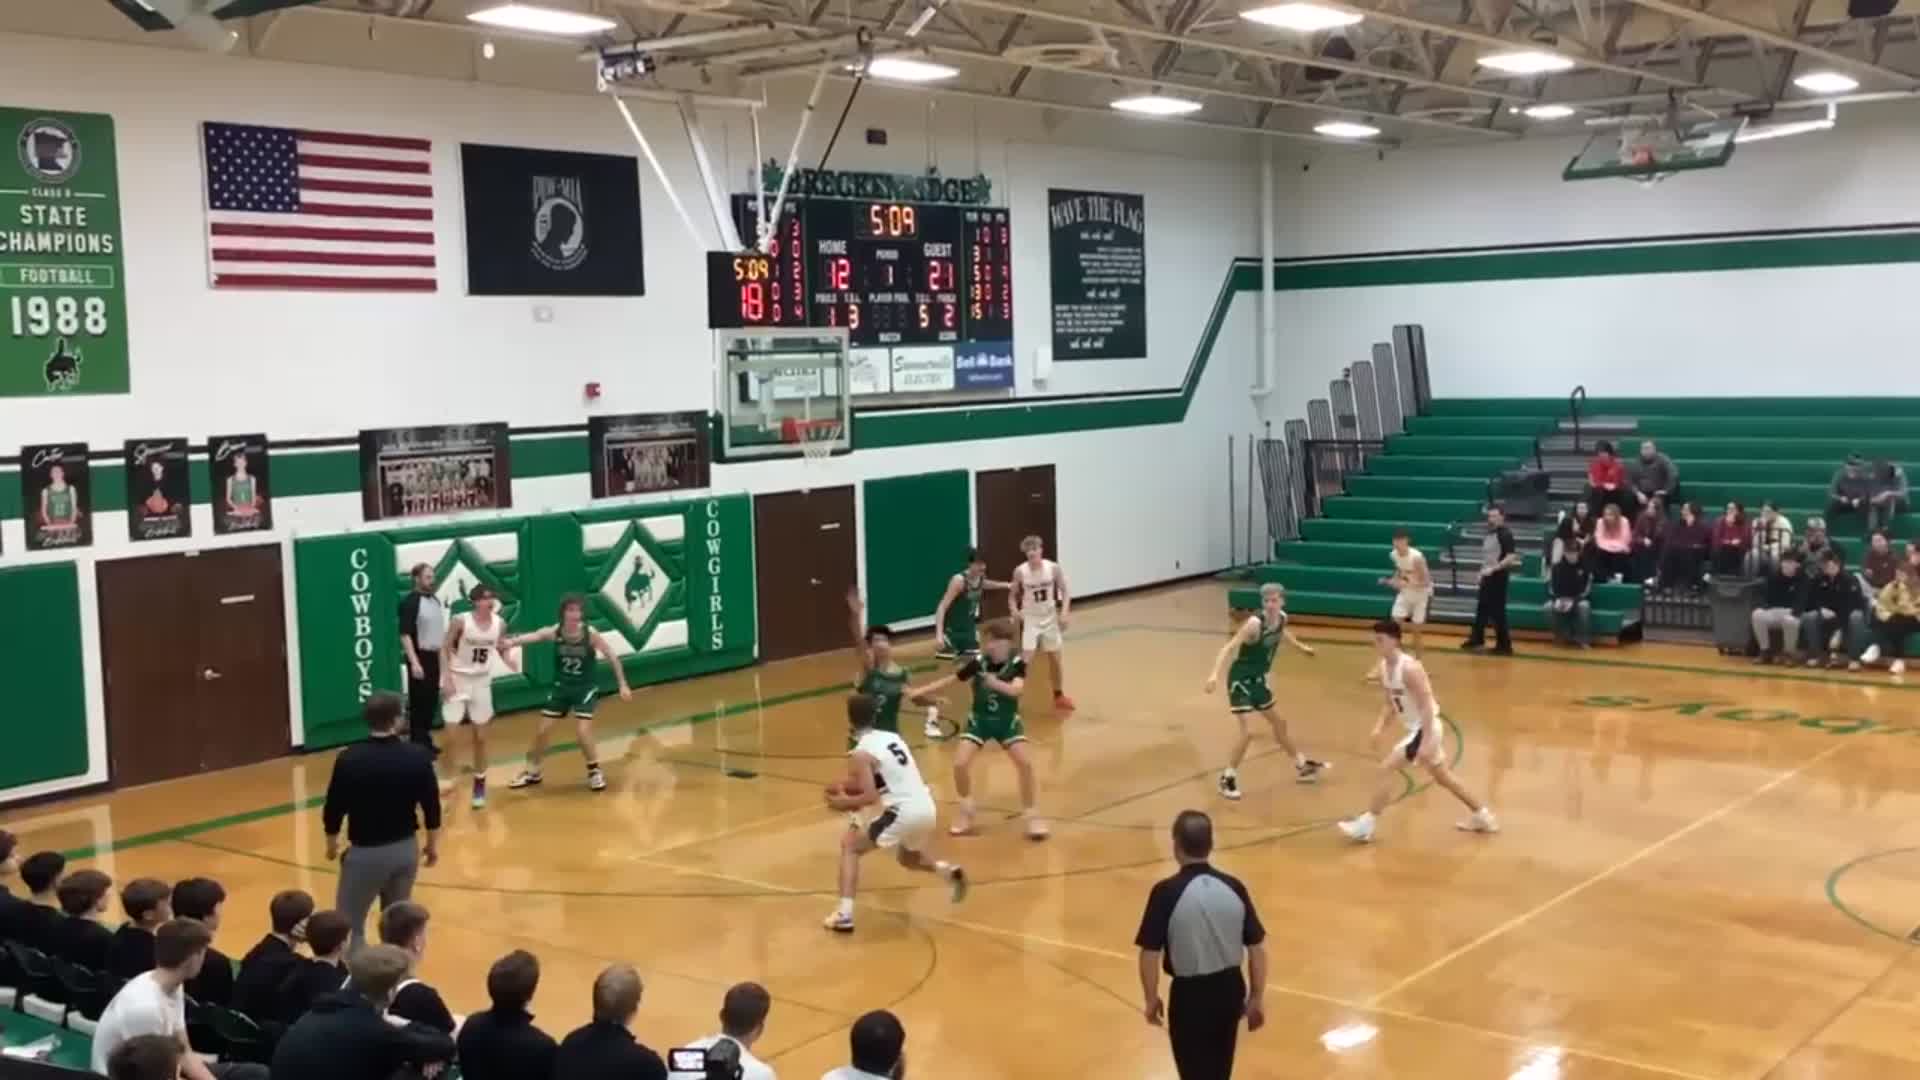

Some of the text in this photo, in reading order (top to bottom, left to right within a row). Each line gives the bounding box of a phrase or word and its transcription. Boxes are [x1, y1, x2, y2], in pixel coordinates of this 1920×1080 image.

[32, 187, 62, 198] CLASS
[20, 205, 87, 226] STATE
[871, 204, 915, 236] 5:09
[1051, 196, 1143, 234] WAVE THE FLAG
[0, 231, 113, 254] CHAMPIONS
[818, 240, 847, 254] HOME
[923, 242, 952, 257] GUEST
[20, 268, 94, 284] FOOTBALL
[733, 258, 769, 281] 5:09
[830, 258, 849, 290] 12
[887, 265, 893, 285] 1
[929, 260, 954, 290] 21
[11, 296, 108, 336] 1988
[829, 306, 836, 328] 1
[849, 303, 859, 330] 3
[919, 303, 929, 329] 5
[944, 303, 955, 329] 2
[957, 354, 1012, 369] Bell Bank
[706, 500, 723, 651] COWGIRLS
[1033, 589, 1047, 603] 13
[350, 548, 373, 703] COWBOYS
[472, 648, 489, 663] 15
[562, 657, 582, 675] 22
[986, 693, 999, 712] 5
[887, 742, 908, 766] 5
